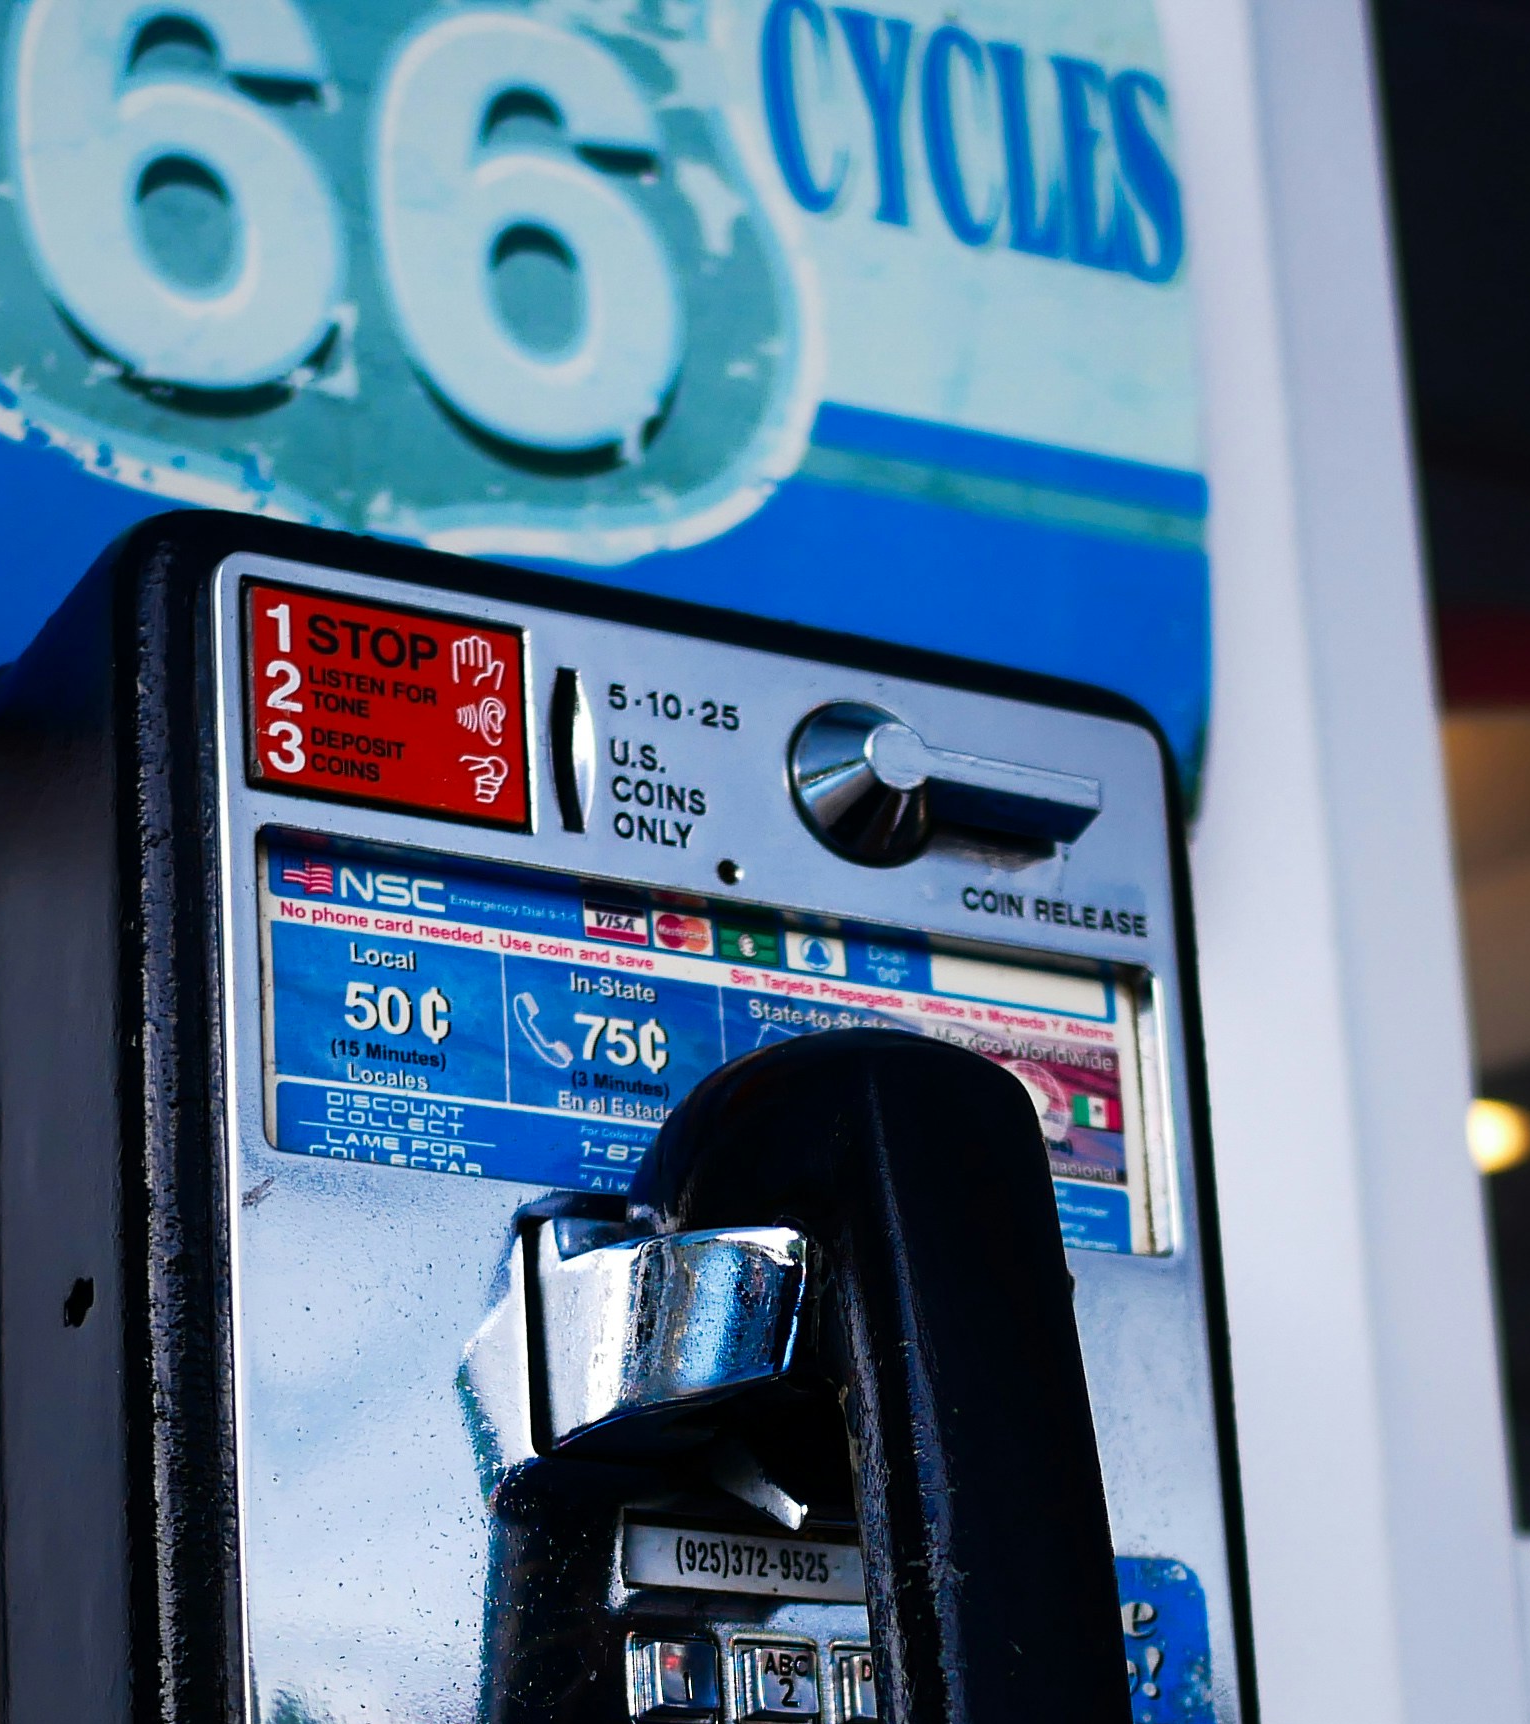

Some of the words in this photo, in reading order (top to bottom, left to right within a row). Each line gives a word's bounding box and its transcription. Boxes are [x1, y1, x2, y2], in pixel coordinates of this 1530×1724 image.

[760, 0, 1187, 285] CYCLES
[12, 0, 684, 476] 66
[267, 604, 290, 652] 1
[308, 614, 438, 670] STOP
[266, 660, 303, 713] 2
[309, 666, 385, 696] LISTEN
[393, 681, 437, 706] FOR
[311, 691, 369, 718] TONE
[268, 721, 305, 773] 3
[311, 728, 405, 760] DEPOSIT
[610, 736, 666, 773] U.S.
[311, 754, 381, 782] COINS
[612, 776, 707, 816] COINS
[614, 812, 693, 848] ONLY
[340, 868, 446, 912] NSC
[451, 894, 518, 916] Emergency
[523, 906, 544, 918] Dial
[595, 912, 636, 932] VISA
[962, 887, 1024, 918] COIN
[1035, 899, 1147, 937] RELEASE
[281, 901, 306, 919] No
[312, 907, 368, 928] phone
[375, 915, 413, 934] card
[419, 924, 483, 944] needed
[500, 934, 531, 952] Use
[538, 942, 573, 958] coin
[579, 946, 610, 964] and
[616, 954, 654, 970] save
[350, 941, 416, 972] Local
[570, 971, 657, 1004] In-State
[730, 969, 756, 984] Sin
[762, 973, 814, 996] Tarjeta
[820, 983, 903, 1010] Prepagada
[989, 1010, 1046, 1030] Moneda
[344, 980, 450, 1044] 50¢
[331, 1038, 361, 1058] (15
[368, 1042, 447, 1073] Minutes)
[573, 1012, 668, 1074] 75¢
[347, 1063, 429, 1092] Locales
[572, 1070, 588, 1090] (3
[594, 1073, 669, 1101] Minutes)
[327, 1091, 465, 1120] DISCOUNT
[558, 1090, 584, 1111] En
[589, 1096, 605, 1114] el
[327, 1108, 465, 1136] COLLECT
[327, 1129, 400, 1151] LAME
[412, 1140, 466, 1159] POR
[676, 1536, 829, 1584] (925)372-9525
[765, 1652, 809, 1676] ABC
[780, 1678, 799, 1708] 2
